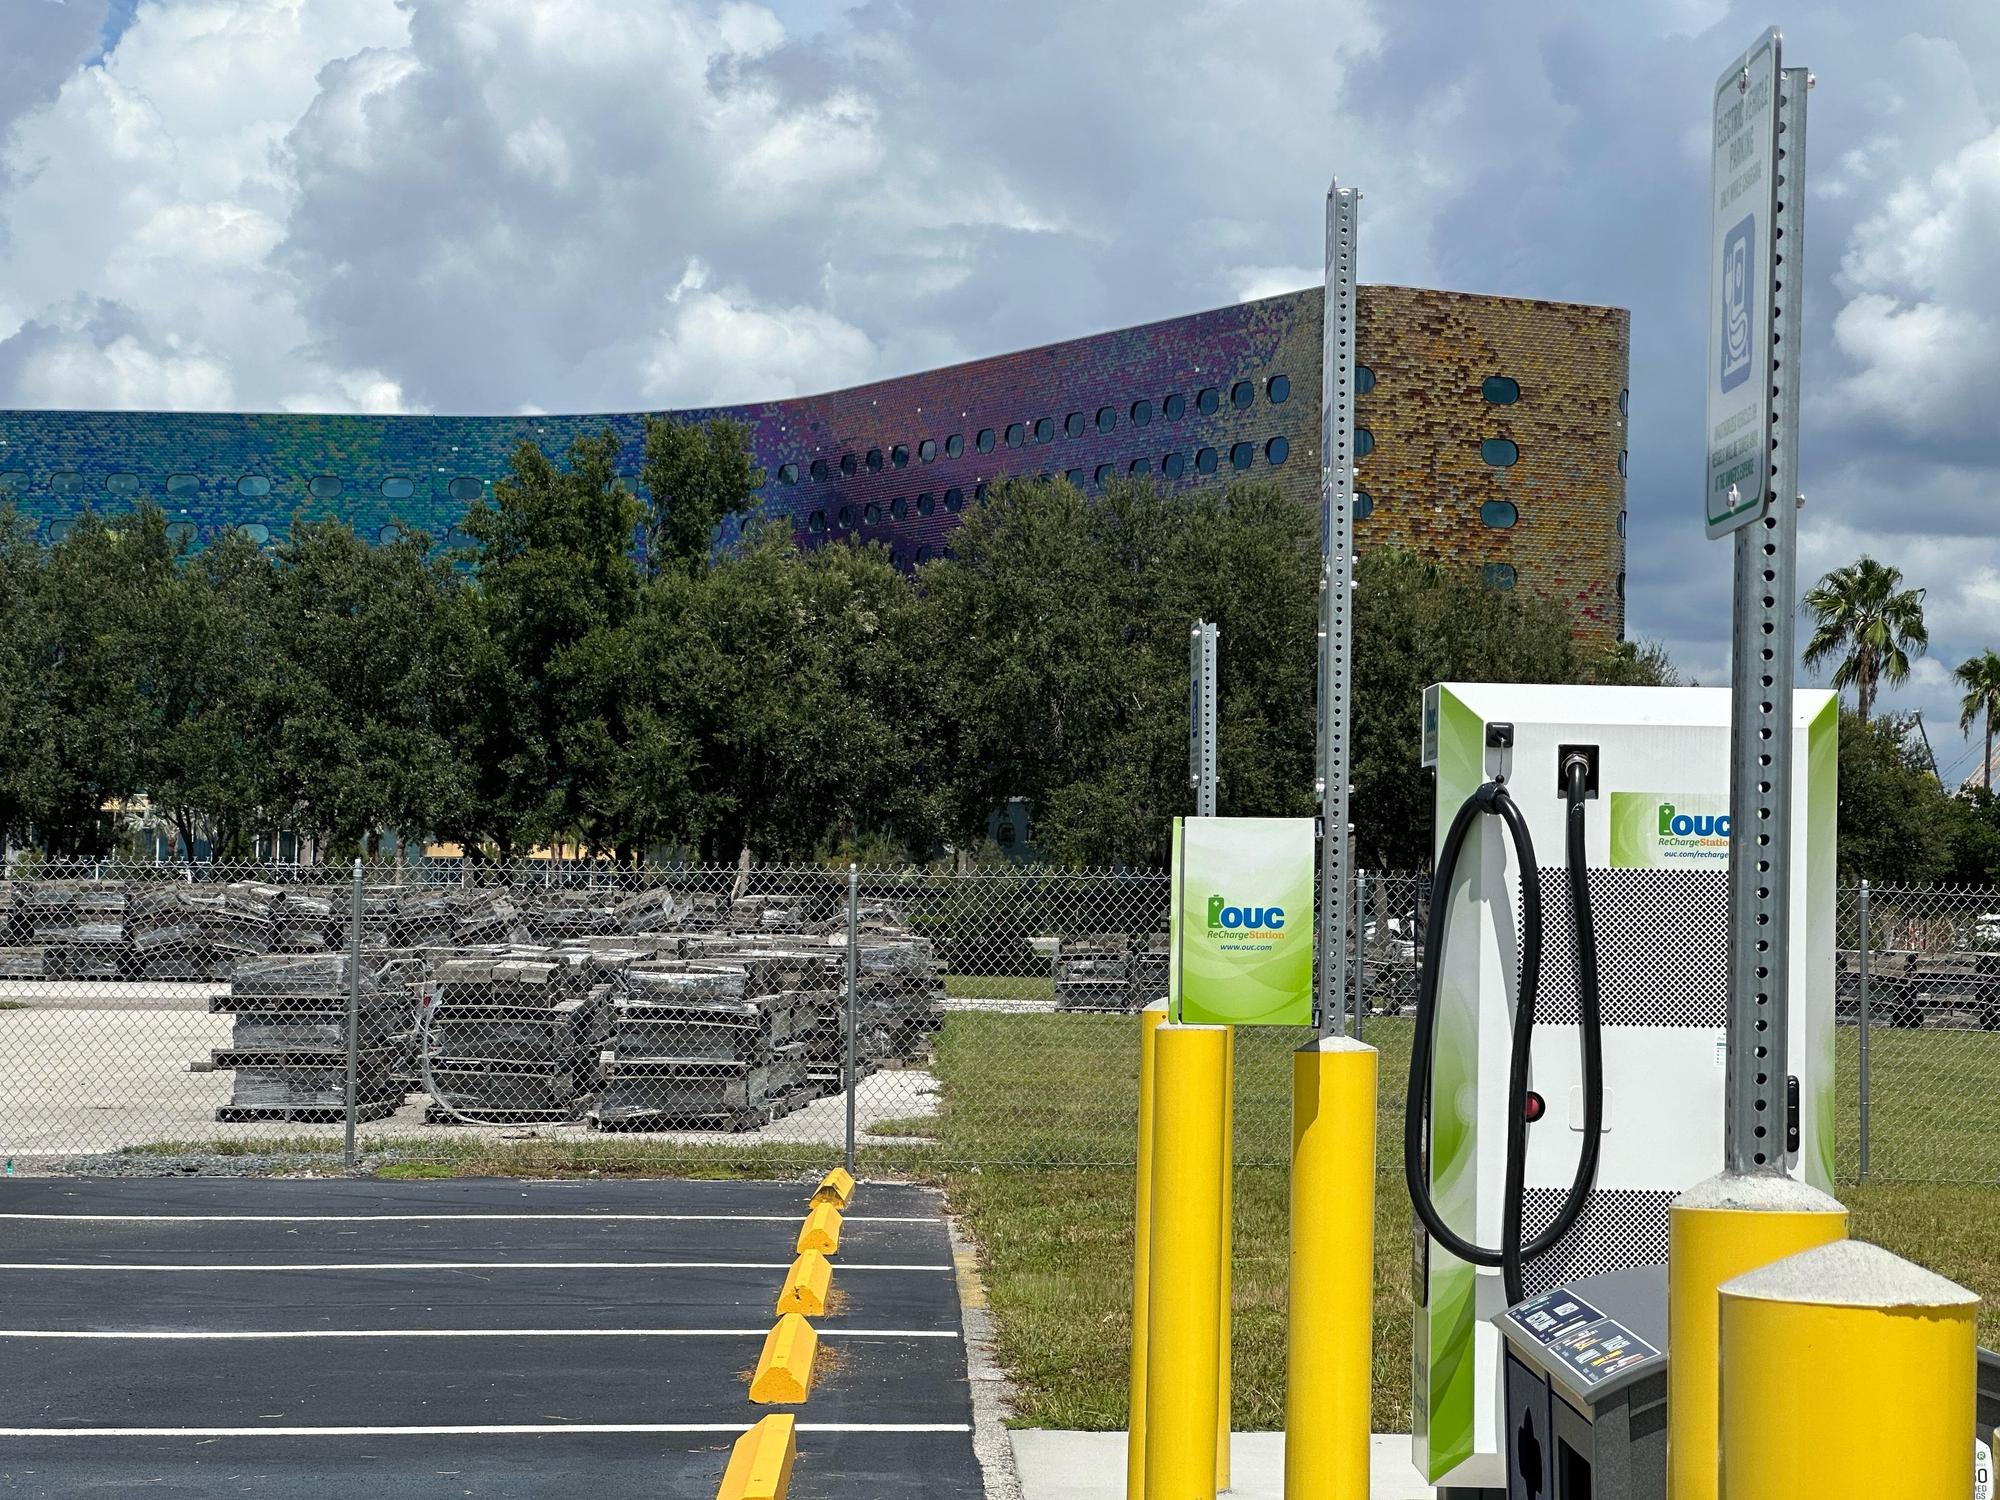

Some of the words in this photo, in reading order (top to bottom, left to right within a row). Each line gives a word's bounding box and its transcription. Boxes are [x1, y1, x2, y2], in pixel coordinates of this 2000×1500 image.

[1658, 837, 1729, 847] ReChargeStatio
[1220, 907, 1285, 930] OUC
[1207, 930, 1285, 941] ReChargeStation
[1220, 943, 1273, 951] www.ouc.com
